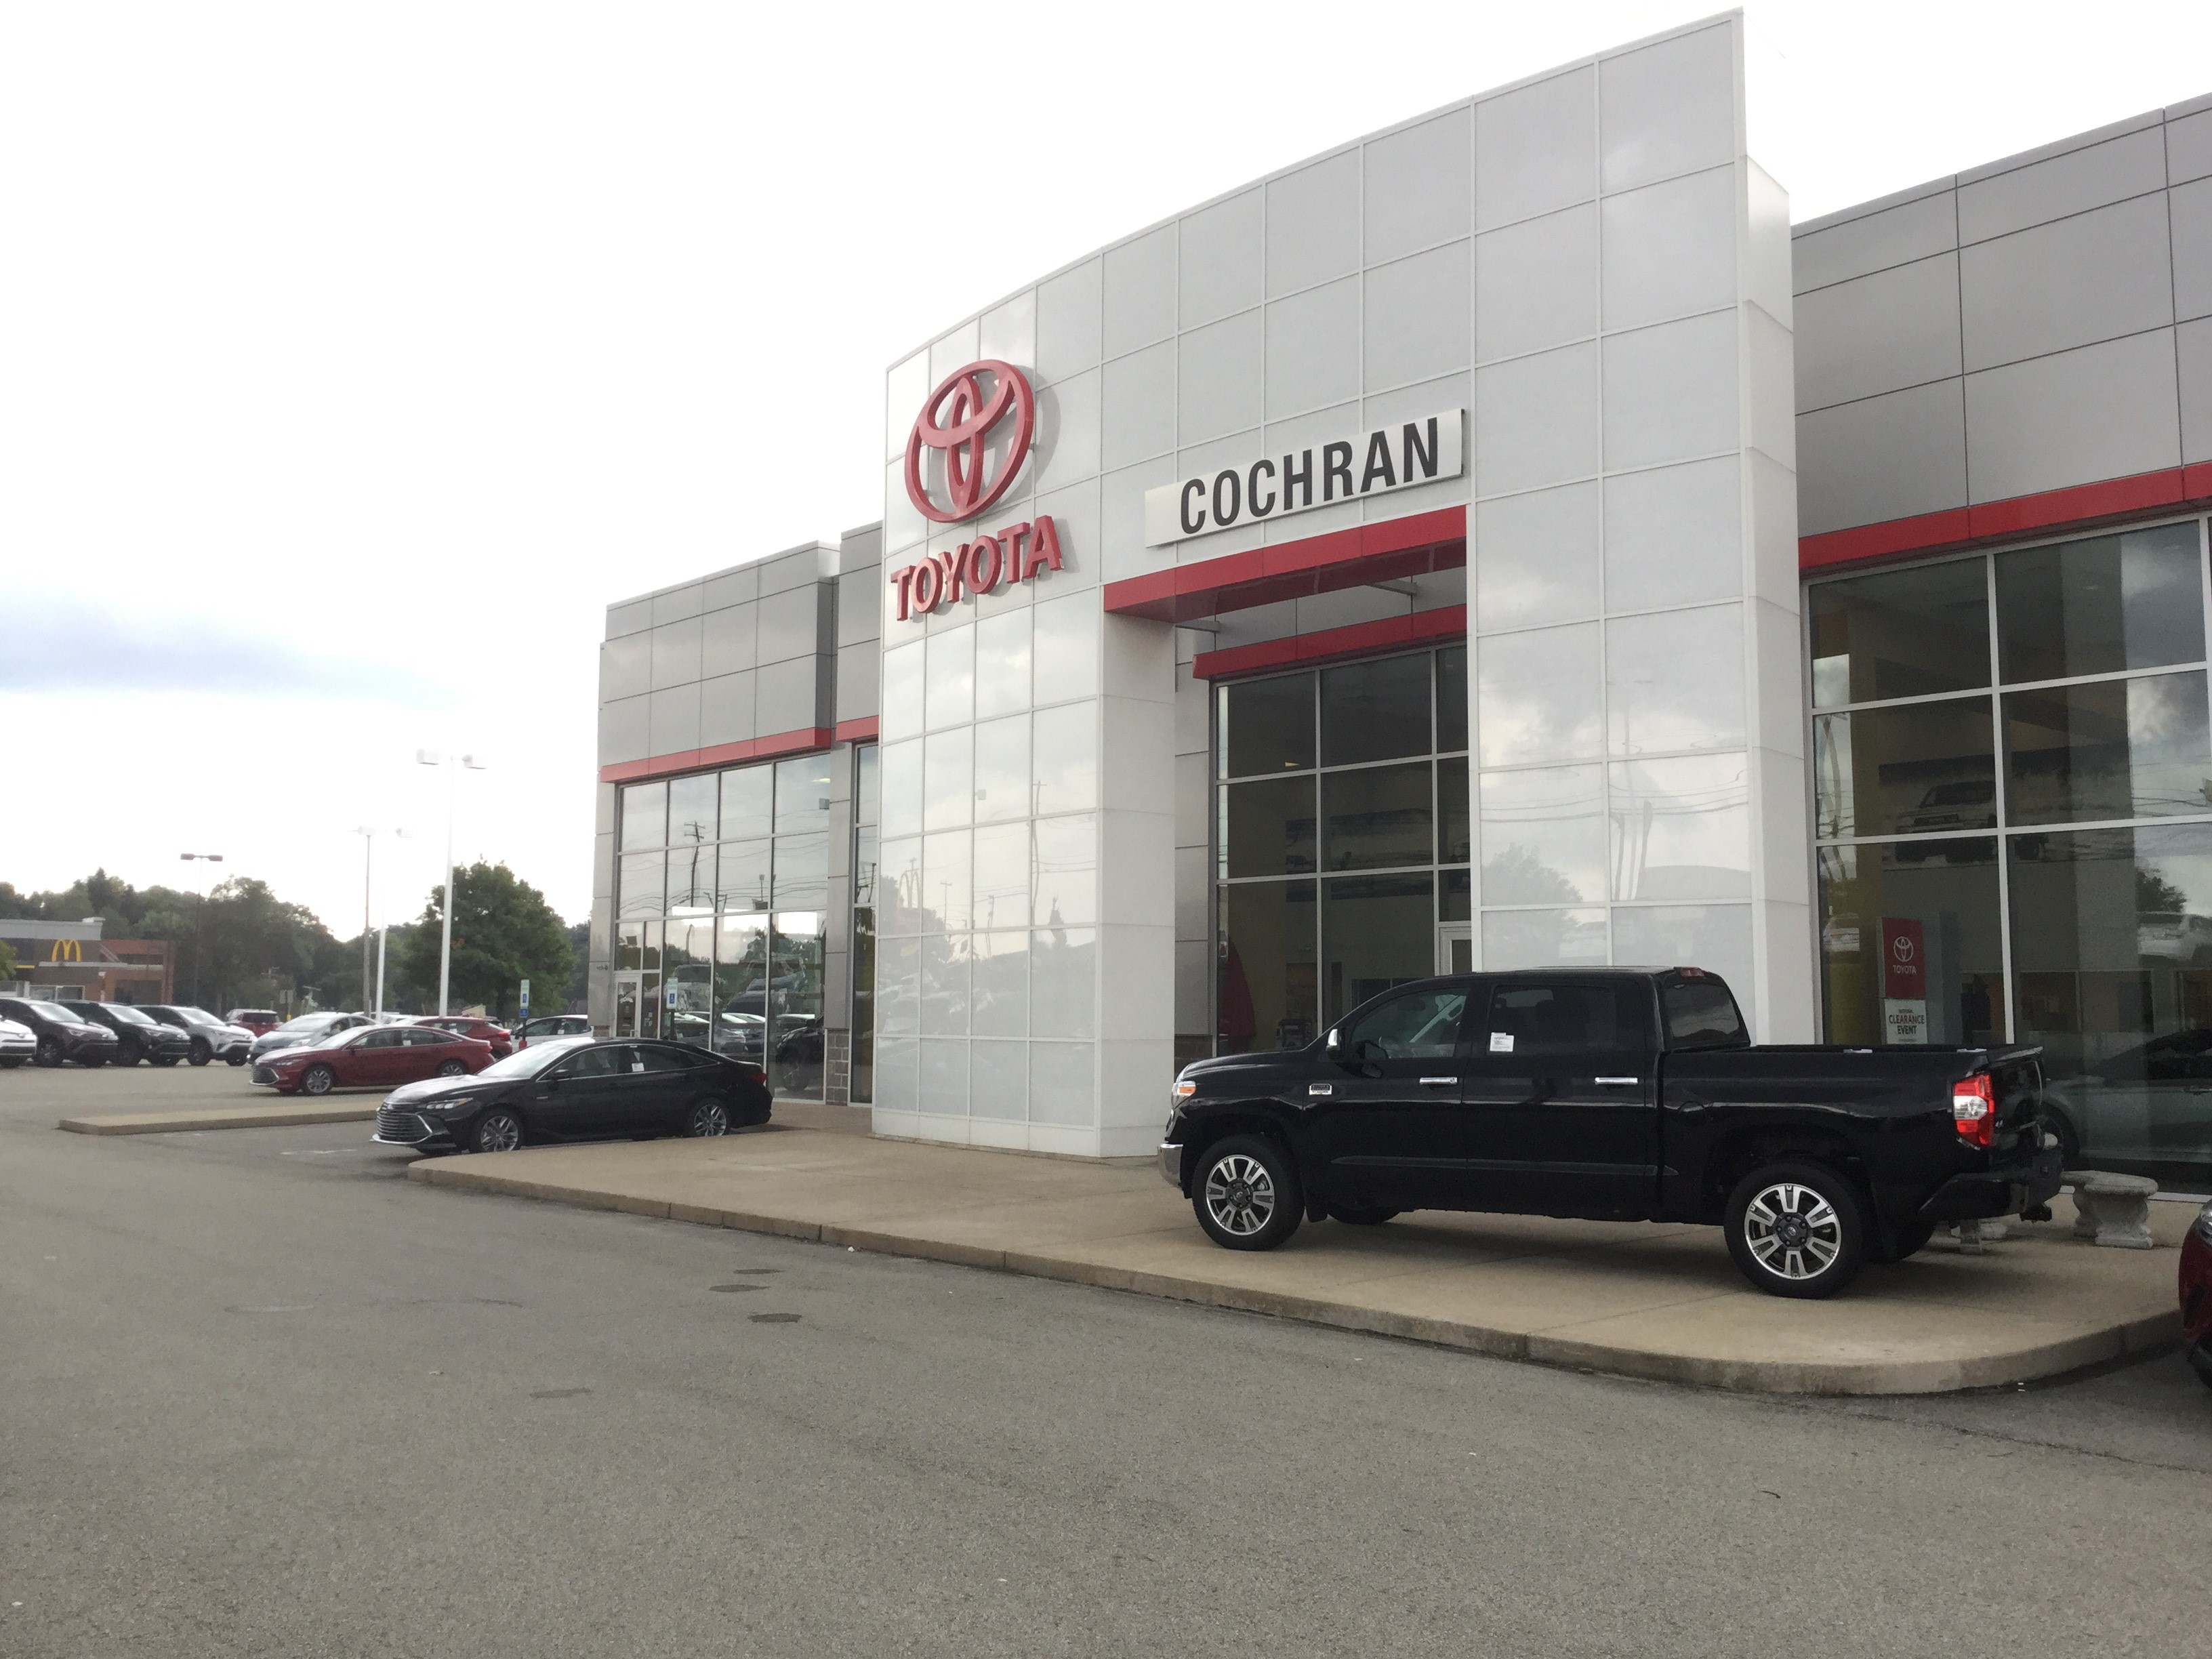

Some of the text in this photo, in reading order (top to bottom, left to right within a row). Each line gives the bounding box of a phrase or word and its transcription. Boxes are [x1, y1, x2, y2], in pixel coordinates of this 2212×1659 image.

[1181, 417, 1438, 535] COCHRAN
[890, 515, 1063, 621] TOYOTA
[1892, 964, 1917, 975] TOYOTA
[1889, 1014, 1925, 1024] CLEARANCE
[1897, 1025, 1917, 1035] EVENT
